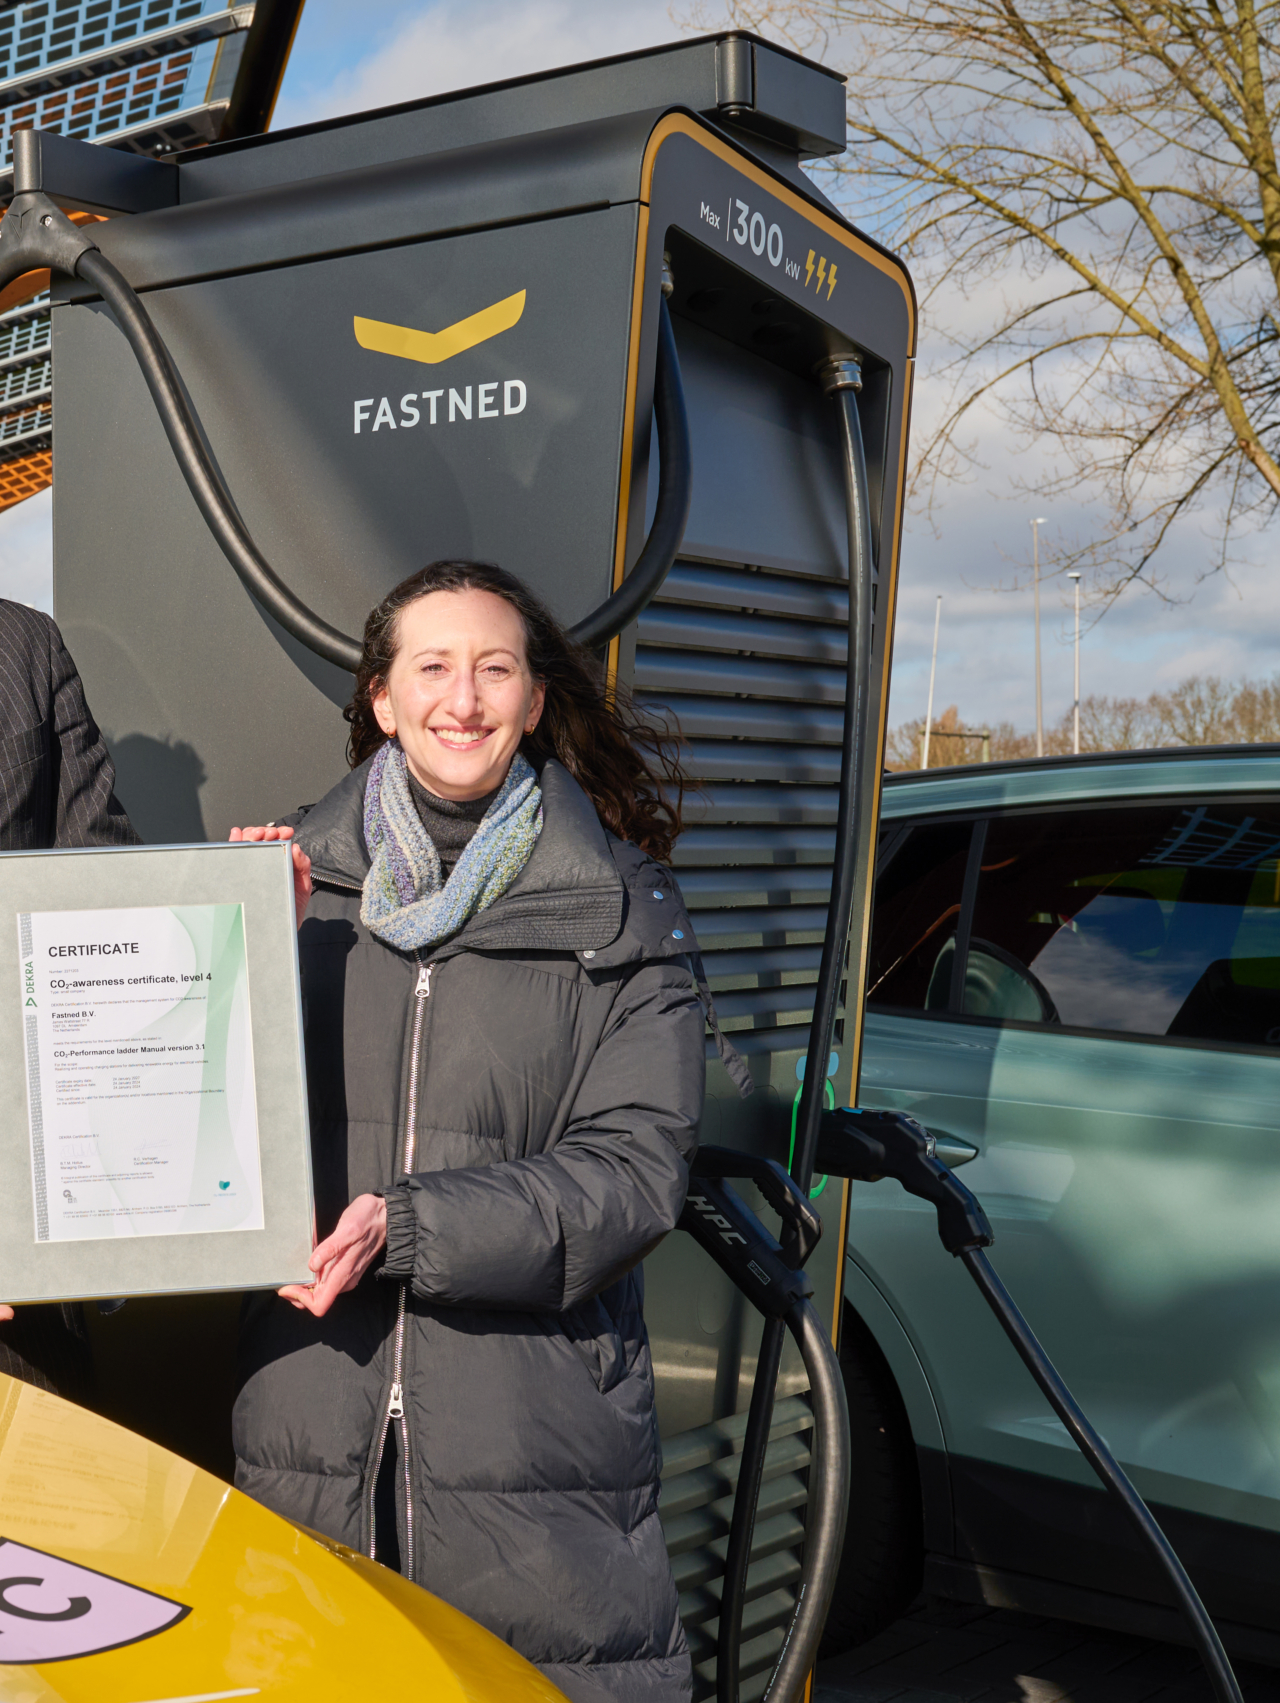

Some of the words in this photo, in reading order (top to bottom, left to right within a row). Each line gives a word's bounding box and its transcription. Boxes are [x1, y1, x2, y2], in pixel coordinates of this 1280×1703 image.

[700, 201, 721, 230] Max
[733, 198, 783, 267] 300
[785, 257, 801, 281] kW
[353, 379, 527, 434] FASTNED
[48, 942, 140, 958] CERTIFICATE
[24, 960, 35, 994] DEKRA
[127, 975, 178, 985] certificate,
[180, 973, 204, 982] level
[206, 972, 212, 981] 4
[686, 1196, 748, 1245] HPC
